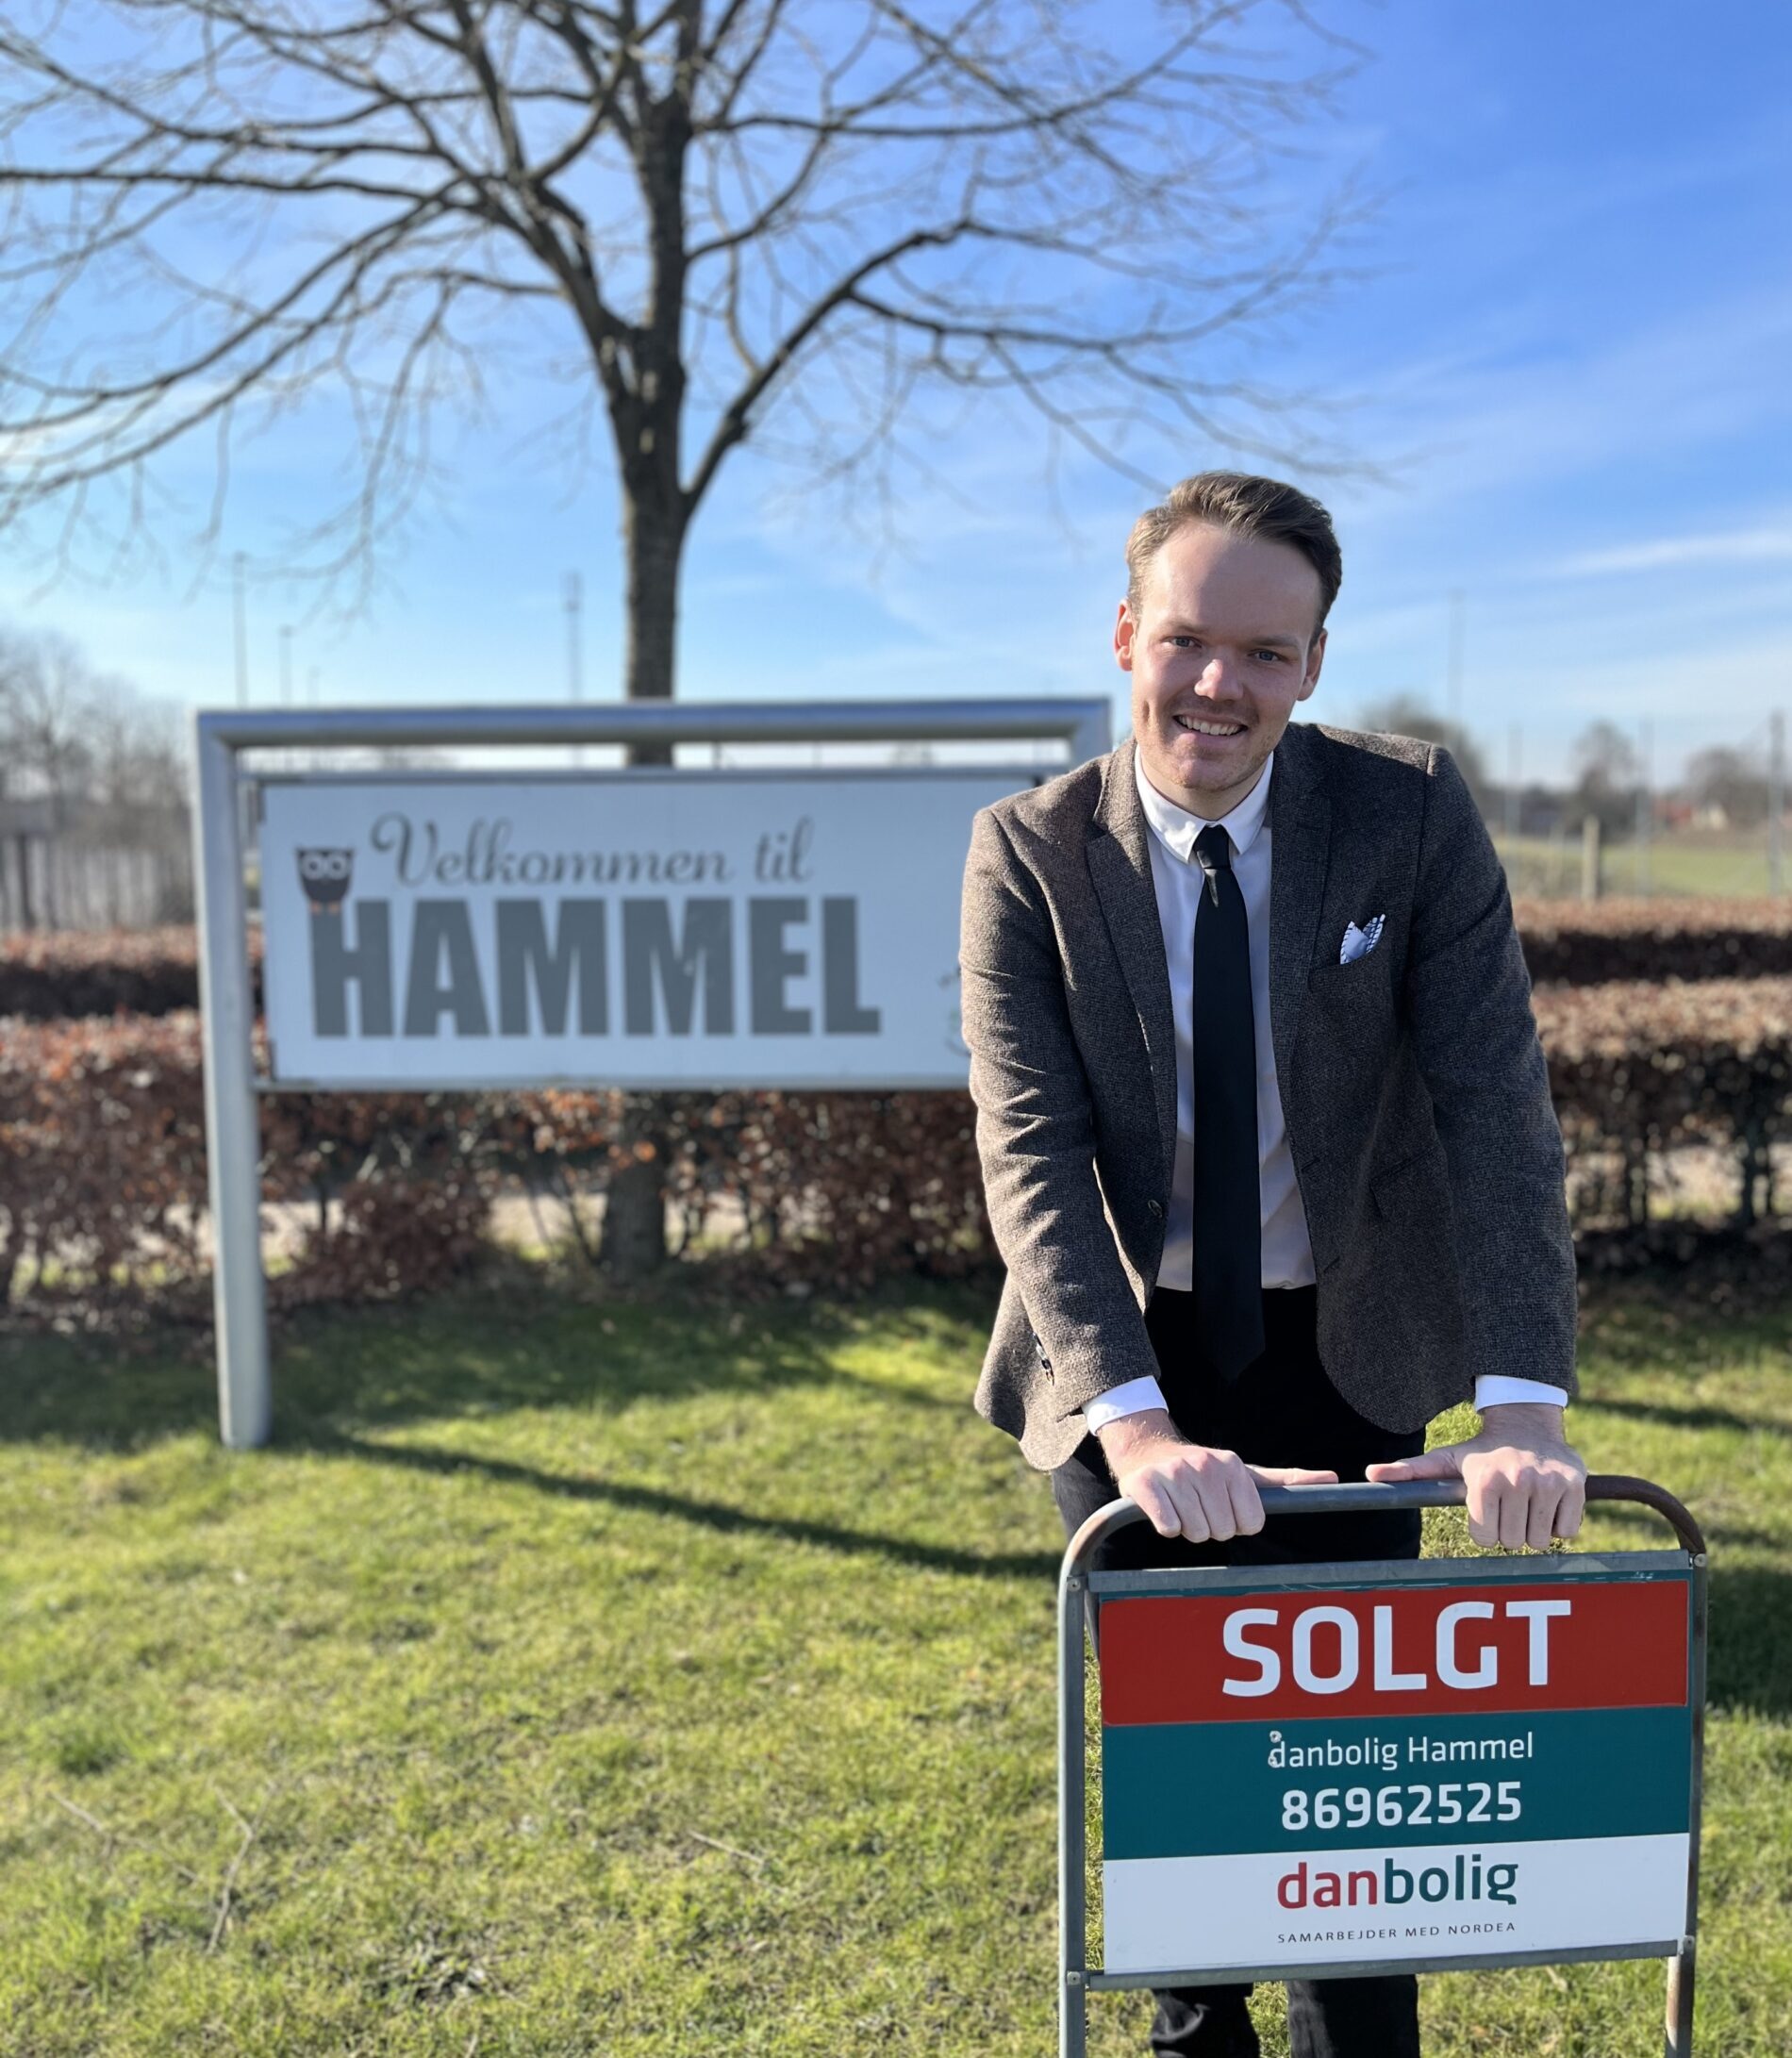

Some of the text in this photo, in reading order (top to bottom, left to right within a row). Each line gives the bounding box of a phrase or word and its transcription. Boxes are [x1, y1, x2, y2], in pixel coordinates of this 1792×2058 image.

[369, 812, 814, 888] Velkommen til
[310, 895, 881, 1037] HAMMEL
[1221, 1600, 1571, 1698] SOLGT
[1268, 1731, 1533, 1771] danbolig Hammel
[1281, 1781, 1521, 1831] 86962525
[1277, 1853, 1519, 1910] danbolig
[1277, 1922, 1516, 1944] SAMARBEJDER MED NORDEA
